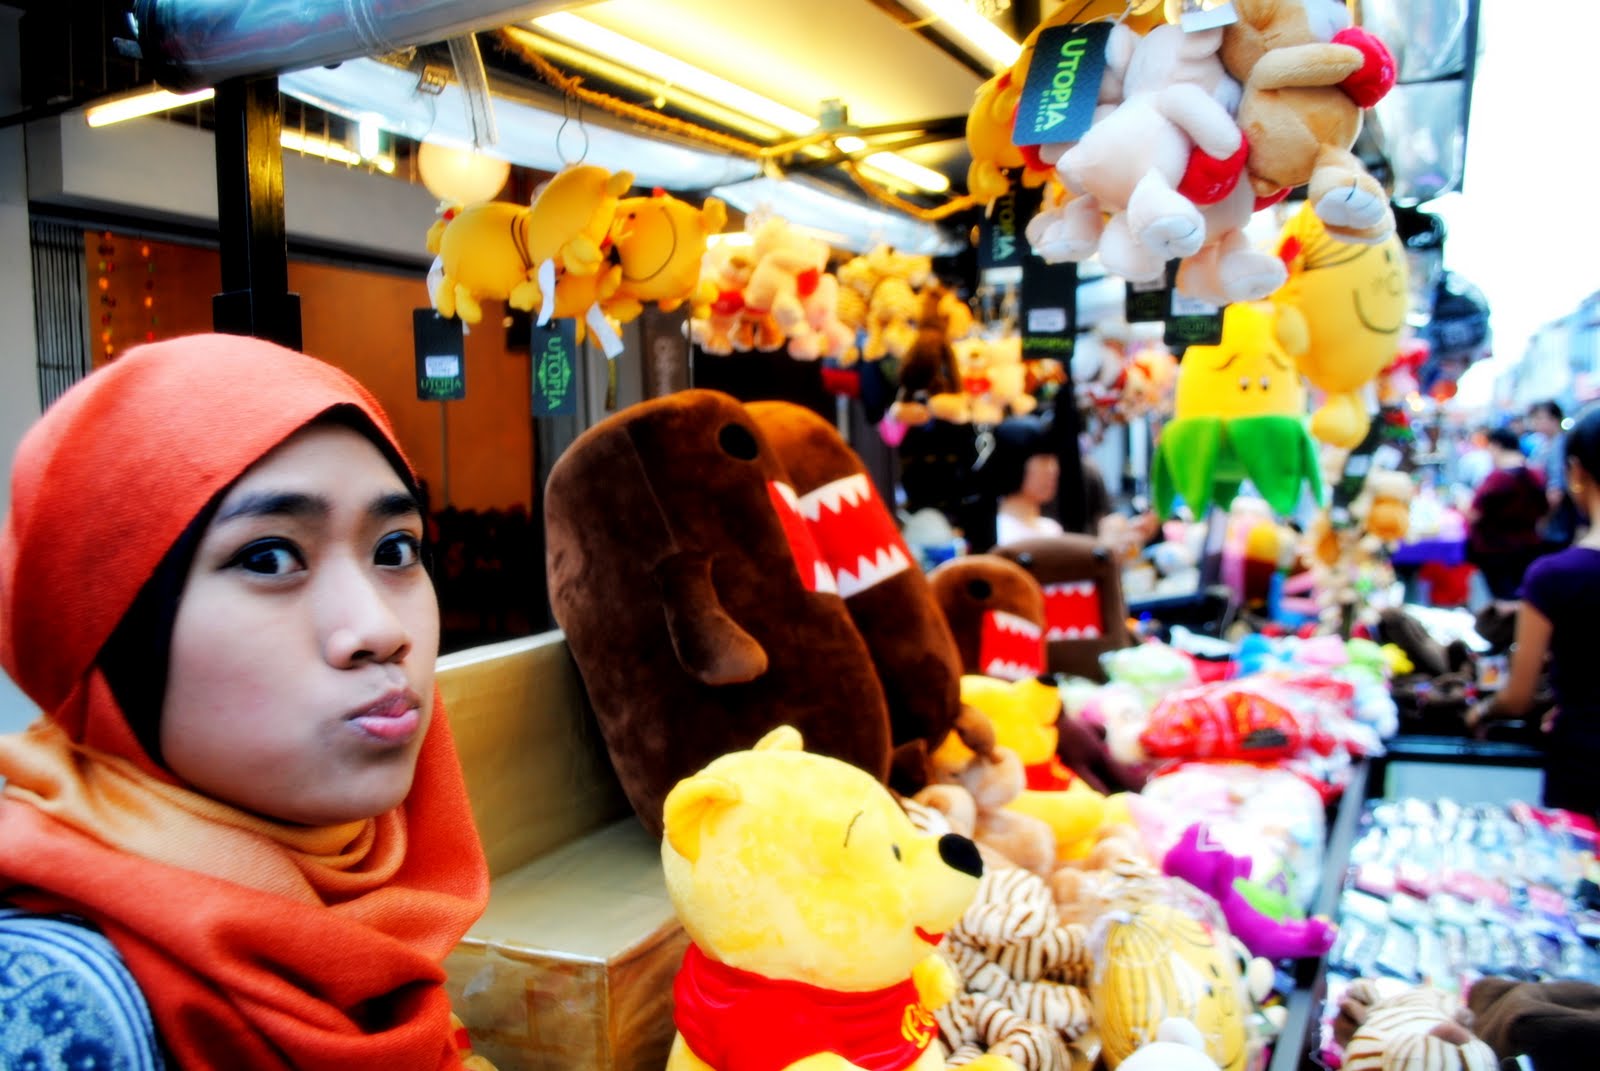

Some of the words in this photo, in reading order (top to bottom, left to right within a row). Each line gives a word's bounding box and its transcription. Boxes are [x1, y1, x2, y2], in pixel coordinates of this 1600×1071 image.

[1043, 38, 1088, 131] UTOPIA
[420, 378, 462, 391] UTOPIA
[547, 336, 562, 411] UTOPIA
